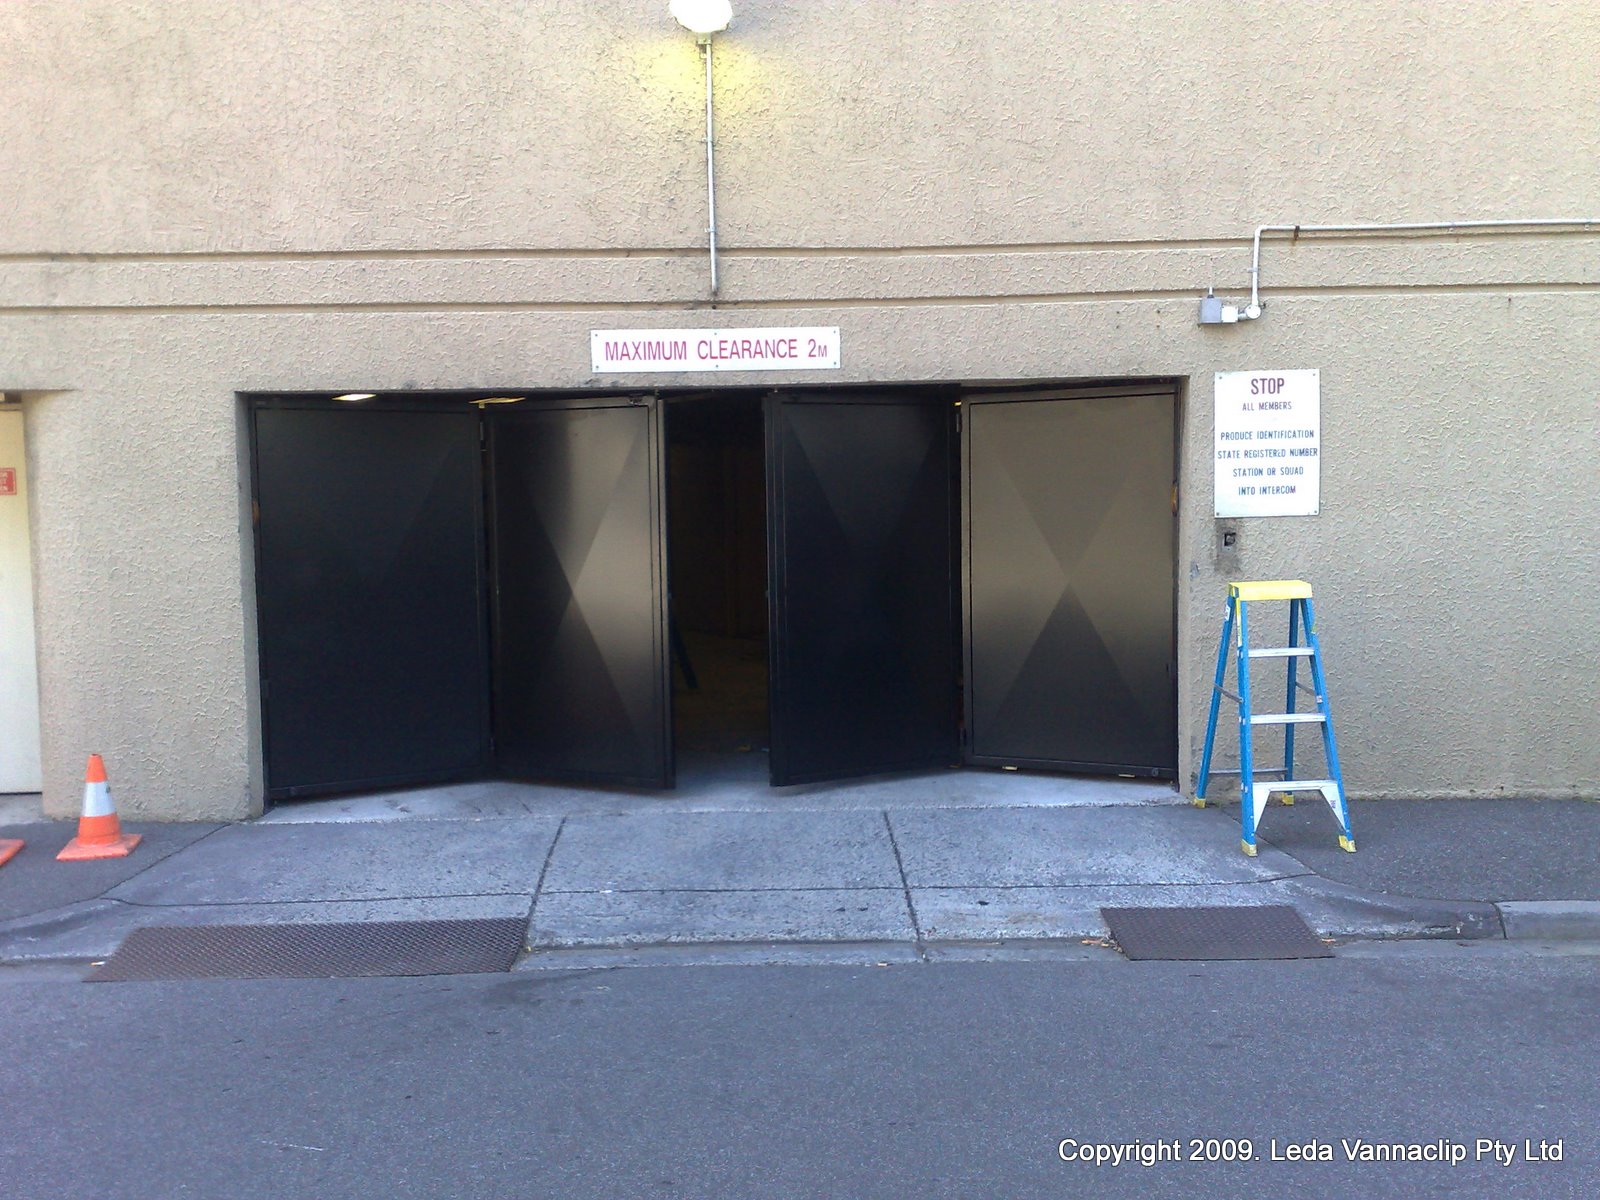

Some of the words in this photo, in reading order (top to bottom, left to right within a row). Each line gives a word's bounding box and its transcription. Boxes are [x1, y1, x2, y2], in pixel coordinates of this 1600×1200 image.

[605, 340, 688, 361] MAXIMUM
[697, 338, 799, 360] CLEARANCE
[1250, 377, 1285, 395] STOP
[1242, 402, 1255, 411] ALL
[1258, 401, 1292, 411] MEMBERS
[1220, 431, 1253, 441] PRODUCE
[1256, 429, 1315, 440] IDENTIFICATION
[1217, 450, 1240, 459] STATE
[1244, 448, 1286, 459] REGISTERED
[1289, 447, 1319, 457] NUMBER
[1232, 468, 1264, 477] STATION
[1267, 467, 1277, 476] OR
[1238, 486, 1256, 495] INTO
[1259, 485, 1296, 495] INTERCOM
